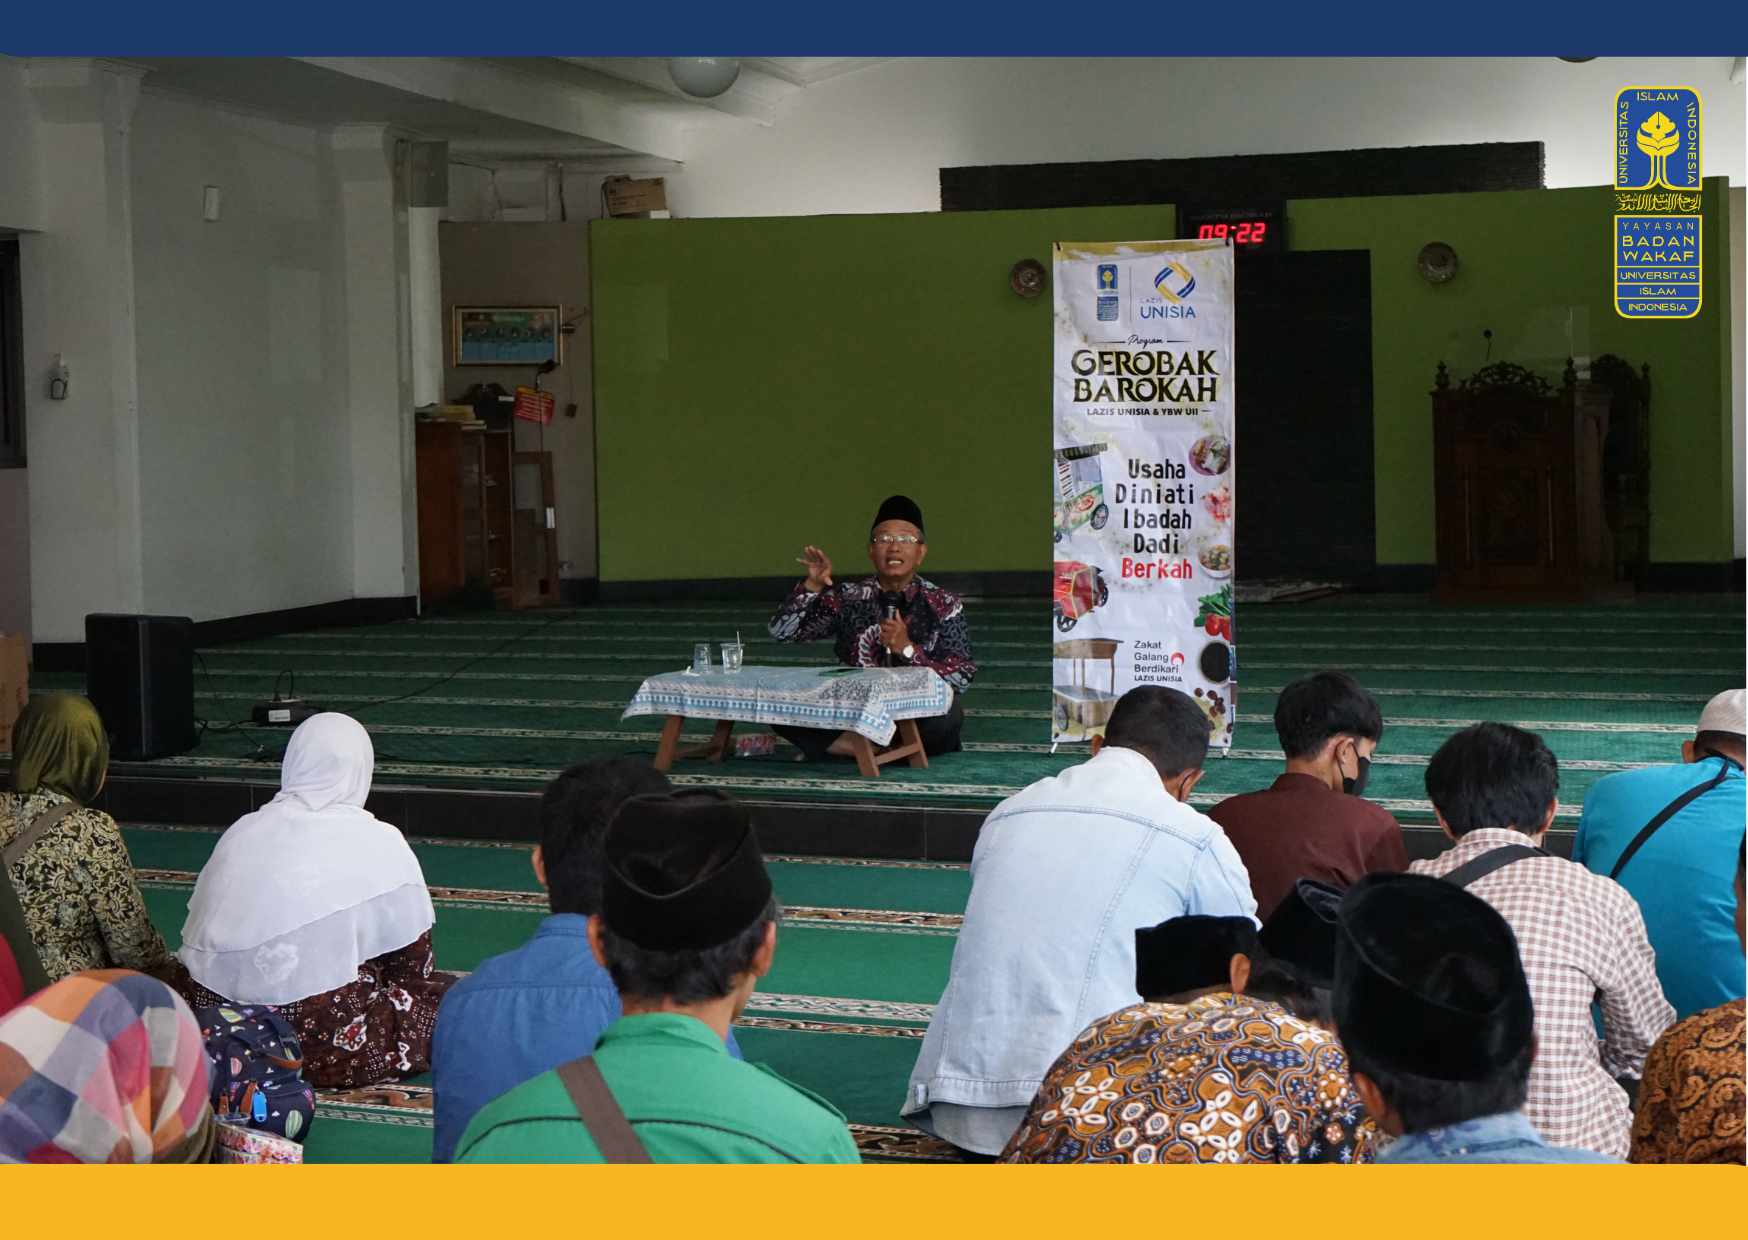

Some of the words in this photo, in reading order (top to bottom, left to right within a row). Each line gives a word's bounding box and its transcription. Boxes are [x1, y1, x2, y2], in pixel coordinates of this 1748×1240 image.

[1140, 305, 1196, 319] UNISIA
[1128, 334, 1164, 349] Program
[1071, 350, 1220, 376] GEROBAK
[1073, 377, 1217, 402] BAROKAH
[1087, 408, 1114, 416] LAZIS
[1118, 408, 1150, 416] UNISIA
[1152, 408, 1160, 416] &
[1161, 408, 1183, 416] YBW
[1128, 458, 1186, 480] Usaha
[1115, 483, 1194, 504] Diniati
[1124, 508, 1192, 530] Ibadah
[1133, 533, 1179, 554] Dadi
[1121, 558, 1193, 580] Berkah
[1134, 640, 1162, 649] Zakat
[1134, 652, 1169, 663] Galang
[1134, 664, 1179, 673] Berdikari
